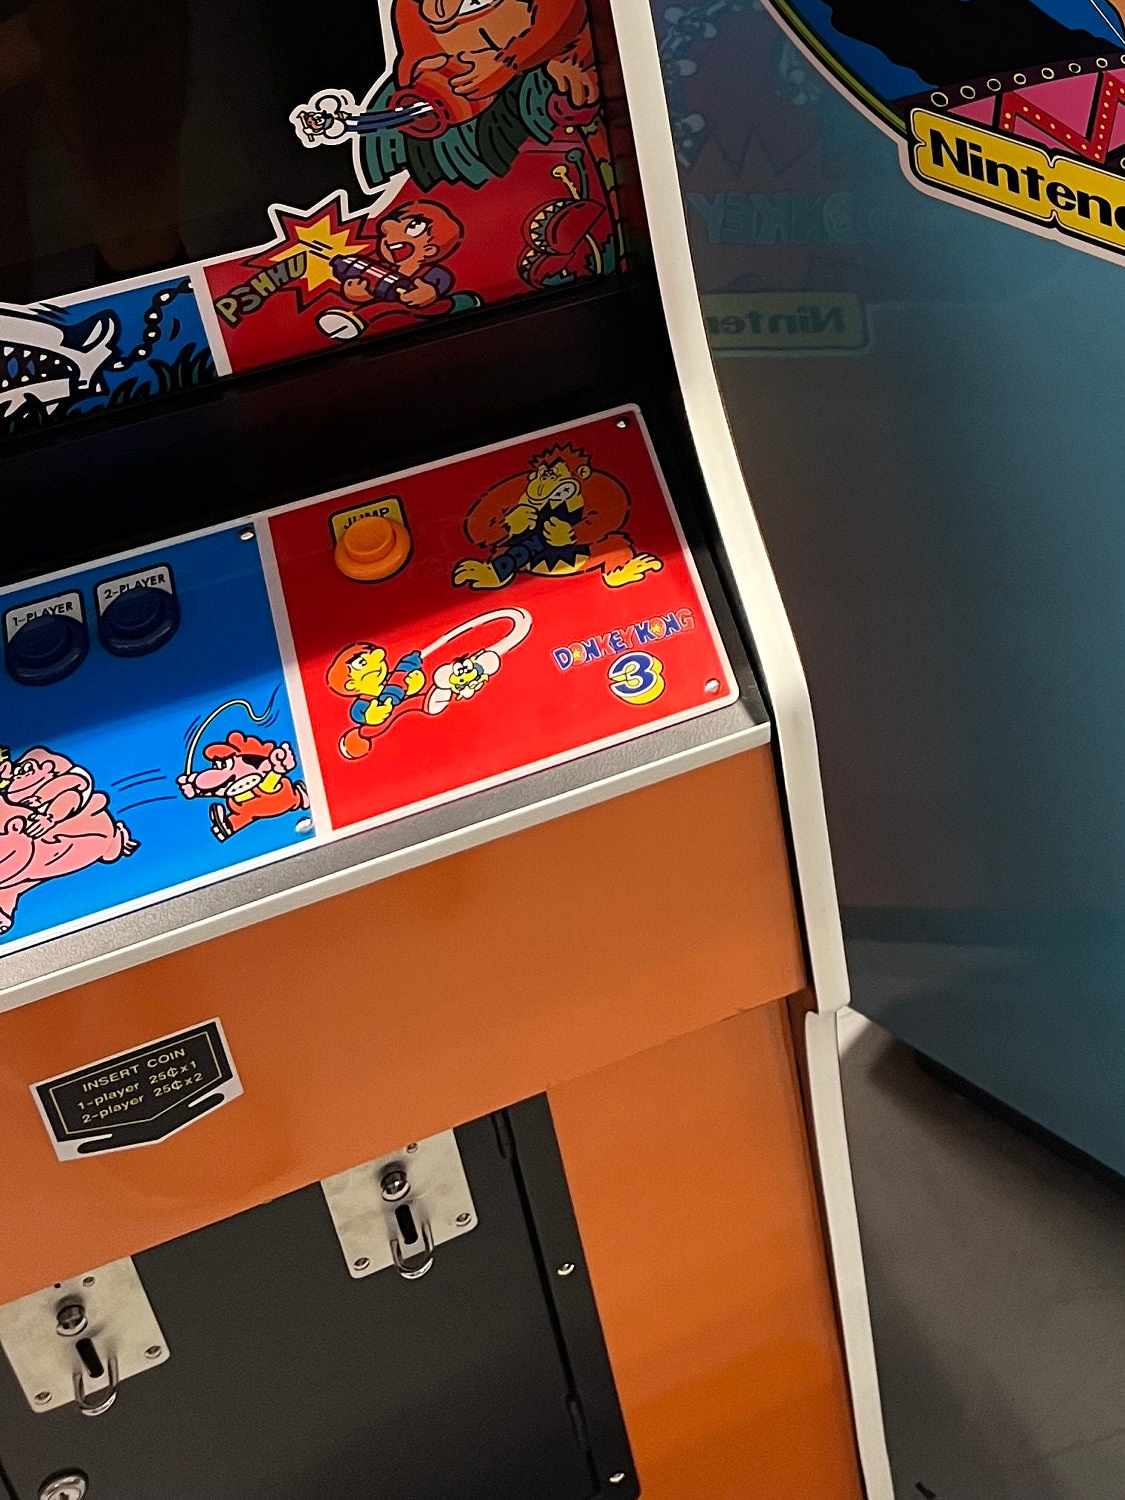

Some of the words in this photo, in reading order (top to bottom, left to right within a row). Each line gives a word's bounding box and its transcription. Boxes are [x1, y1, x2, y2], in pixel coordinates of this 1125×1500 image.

[552, 625, 637, 672] DONKEY
[634, 607, 696, 647] KONG
[608, 651, 665, 705] 3
[82, 1064, 140, 1093] INSERT
[147, 1048, 186, 1069] COIN
[77, 1082, 140, 1111] 1-player
[81, 1095, 145, 1124] 2-player
